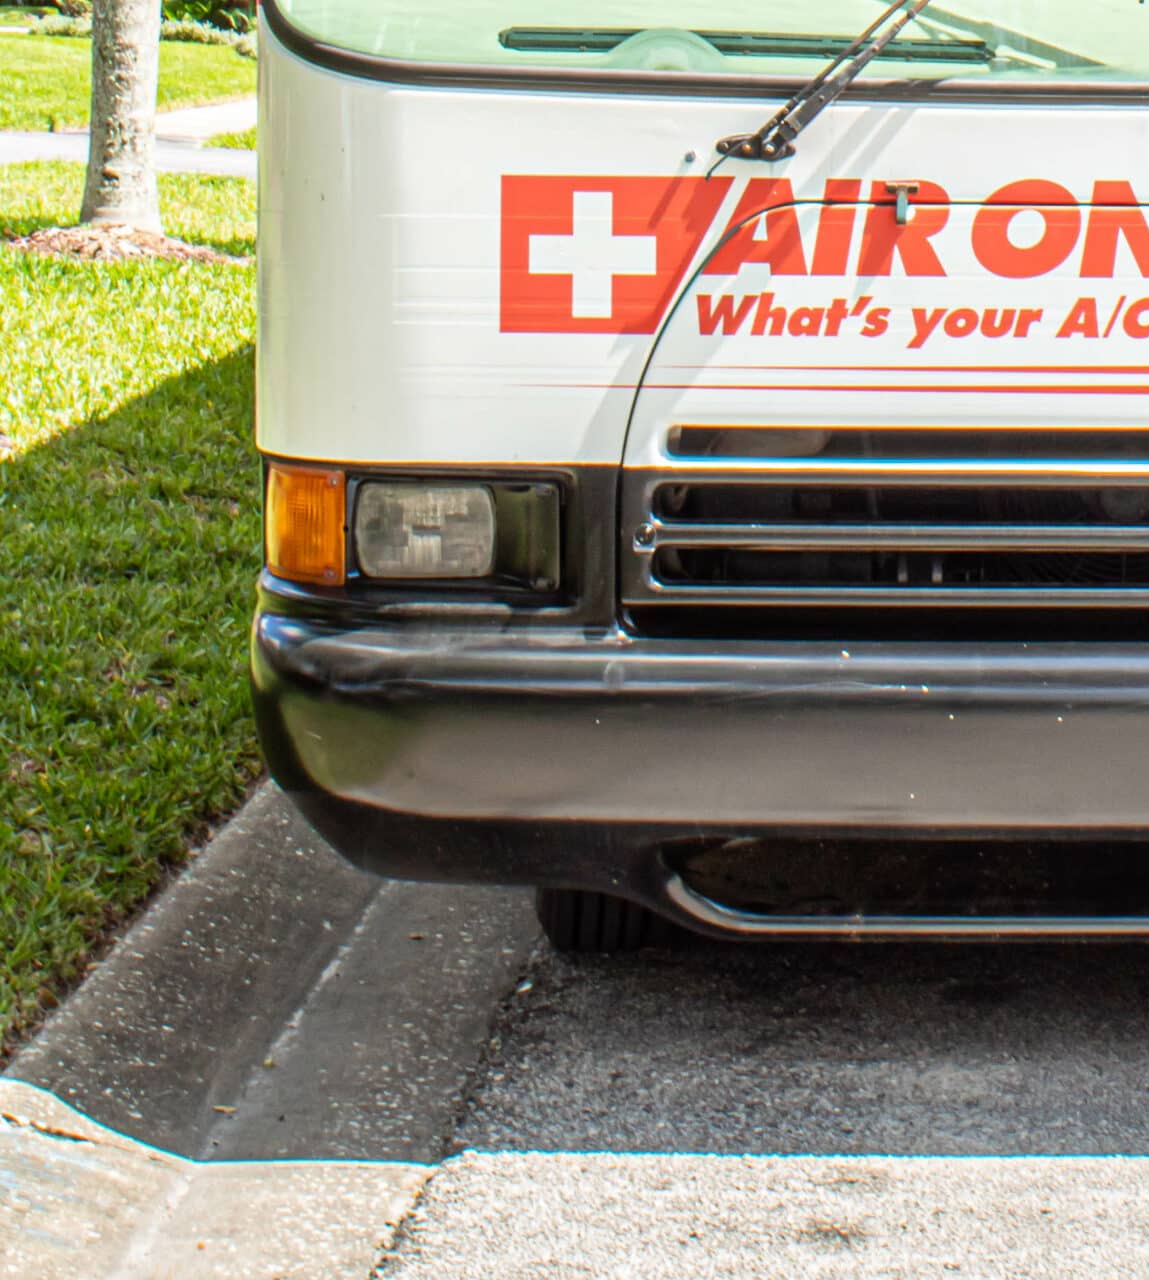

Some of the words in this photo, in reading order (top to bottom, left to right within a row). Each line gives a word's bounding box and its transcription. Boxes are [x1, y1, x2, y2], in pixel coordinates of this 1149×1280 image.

[699, 177, 948, 277] AIR
[696, 291, 891, 337] What's
[906, 308, 1043, 349] your
